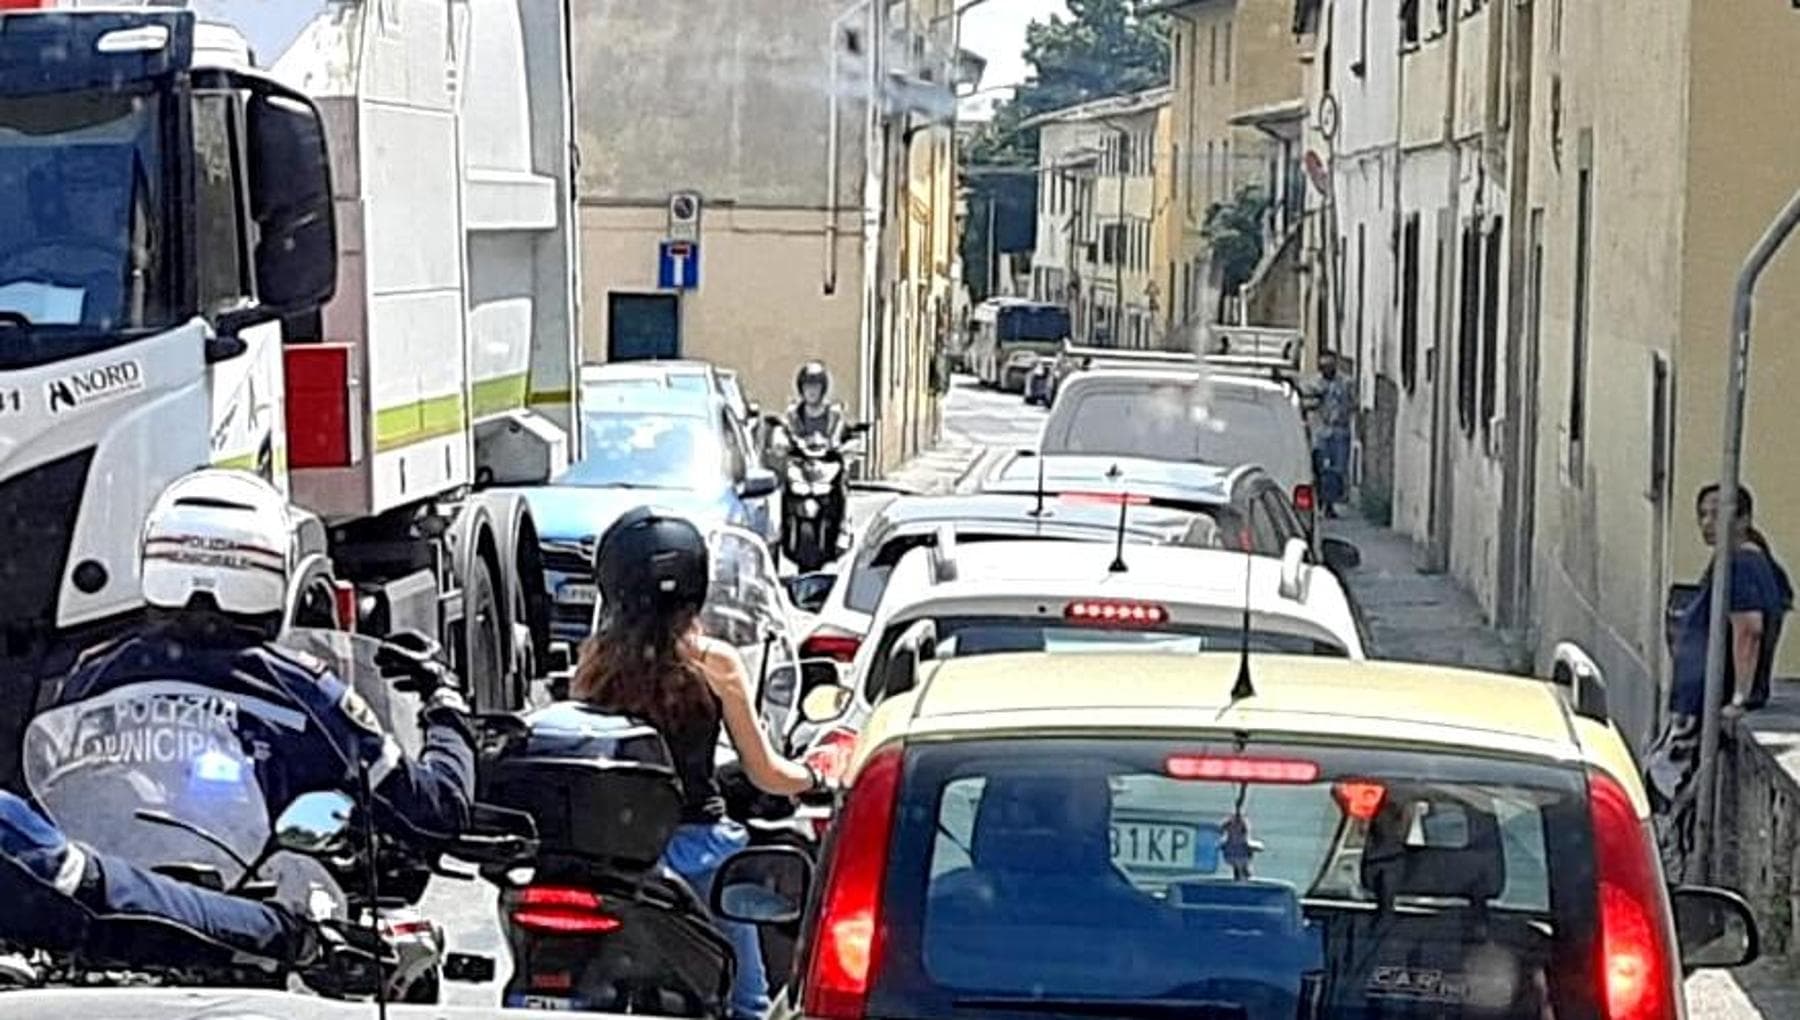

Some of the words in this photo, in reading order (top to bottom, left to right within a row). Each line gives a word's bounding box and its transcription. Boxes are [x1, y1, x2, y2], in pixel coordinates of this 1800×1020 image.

[72, 360, 139, 395] NORD
[113, 696, 239, 731] POLIZIA
[78, 725, 272, 763] UNICIPAE
